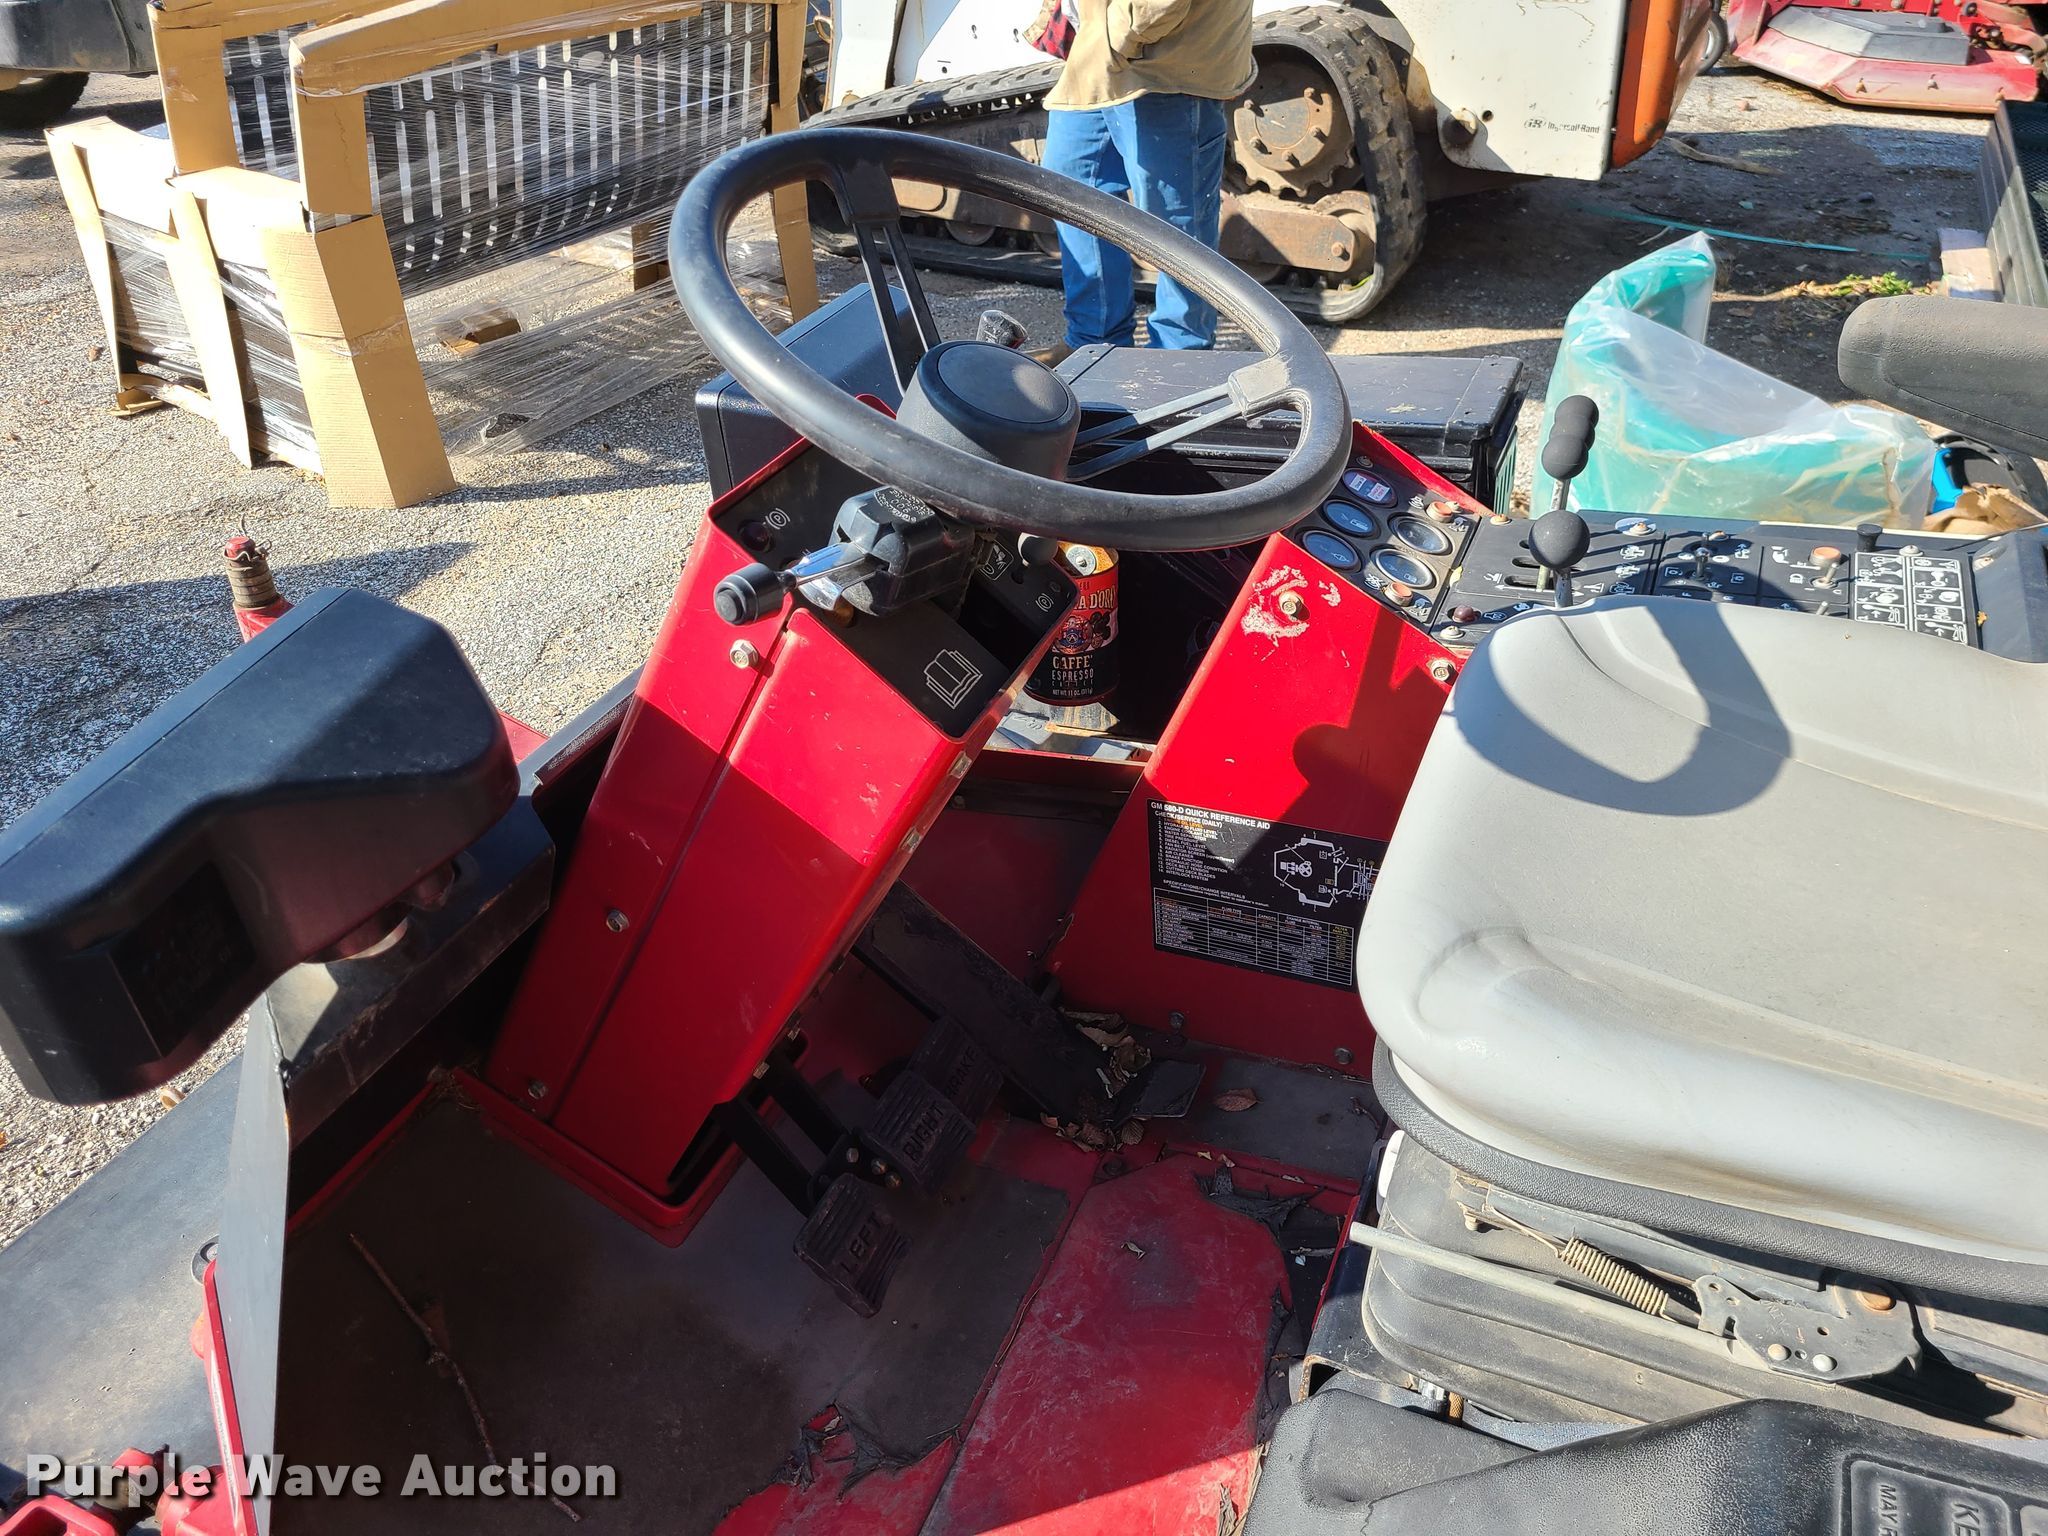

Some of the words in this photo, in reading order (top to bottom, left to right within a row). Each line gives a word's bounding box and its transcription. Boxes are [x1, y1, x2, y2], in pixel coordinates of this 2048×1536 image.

[1051, 668, 1094, 681] ESPRESSO
[1150, 801, 1162, 810] GM
[1185, 807, 1209, 819] QUICK
[1210, 812, 1256, 828] REFERENCE
[1257, 821, 1270, 830] AID
[1201, 818, 1222, 828] (DAILY)
[902, 1101, 945, 1163] RIGHT
[840, 1210, 884, 1275] LEFT
[1879, 1484, 1898, 1524] MAY
